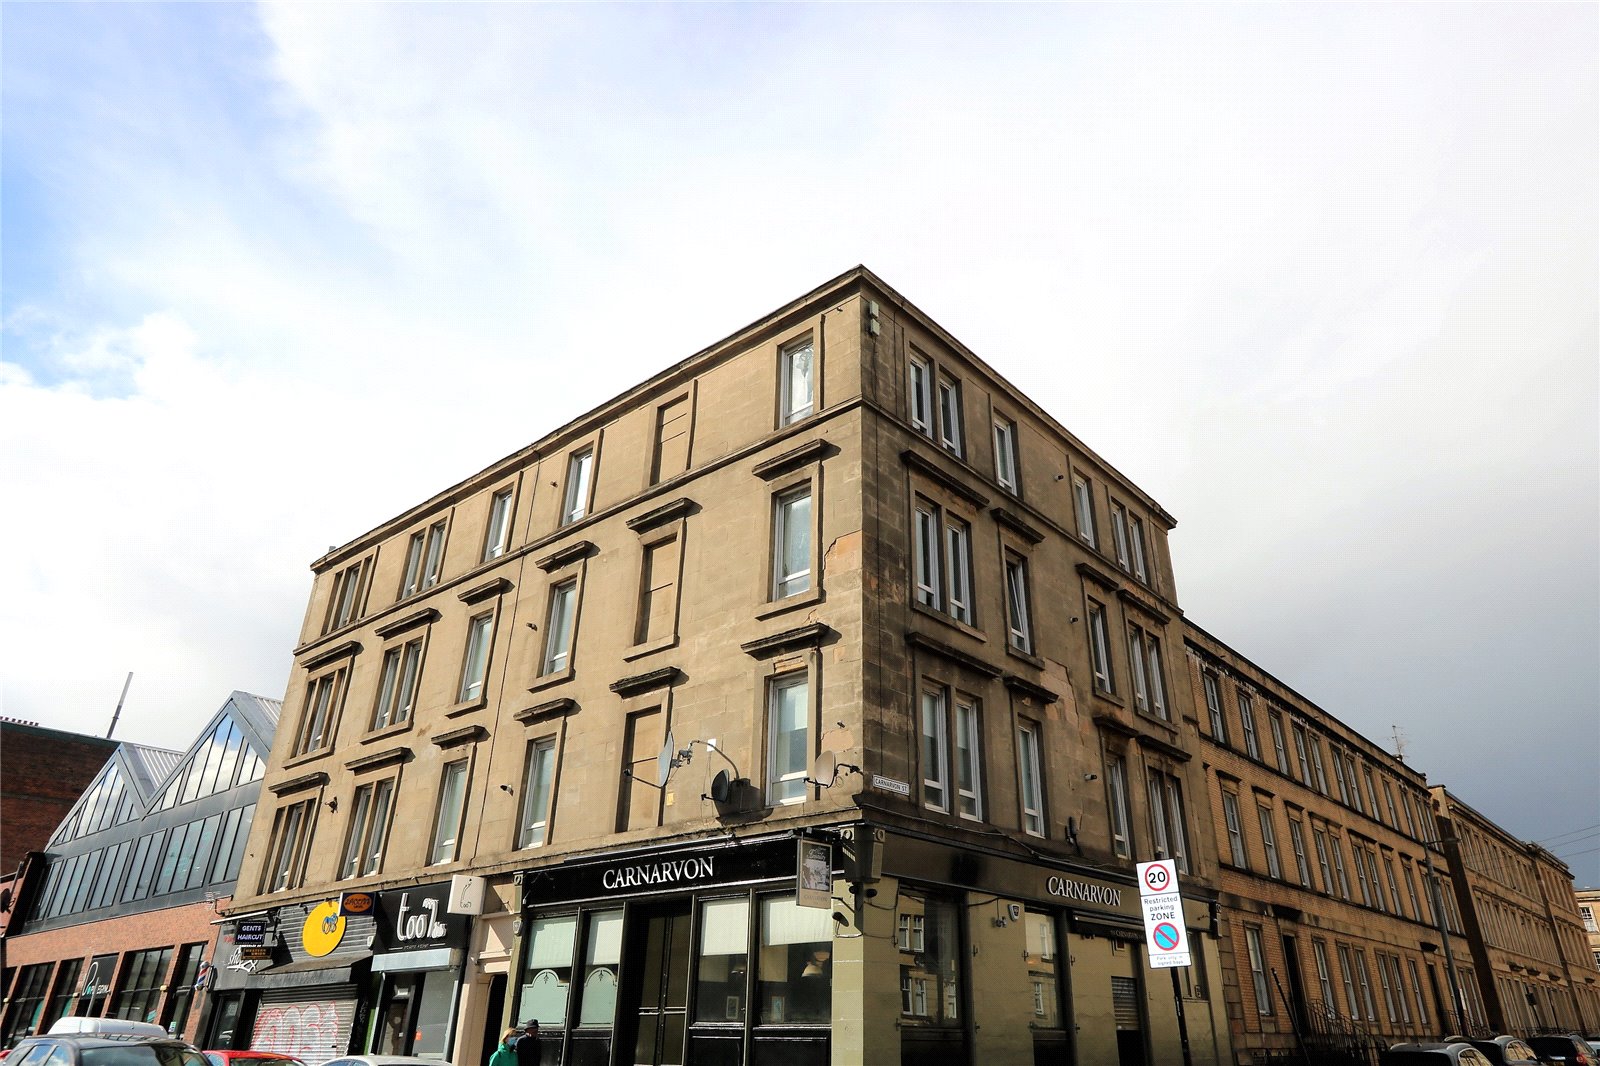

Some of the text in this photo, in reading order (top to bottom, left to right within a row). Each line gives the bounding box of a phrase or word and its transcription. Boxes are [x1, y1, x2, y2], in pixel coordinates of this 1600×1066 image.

[875, 778, 901, 790] CARNARVON
[602, 856, 715, 889] CARNARVON
[1148, 872, 1166, 883] 20
[1048, 876, 1121, 906] CARNARVON
[1144, 896, 1178, 905] Restricted
[1149, 904, 1175, 912] parking
[1151, 912, 1175, 921] ZONE
